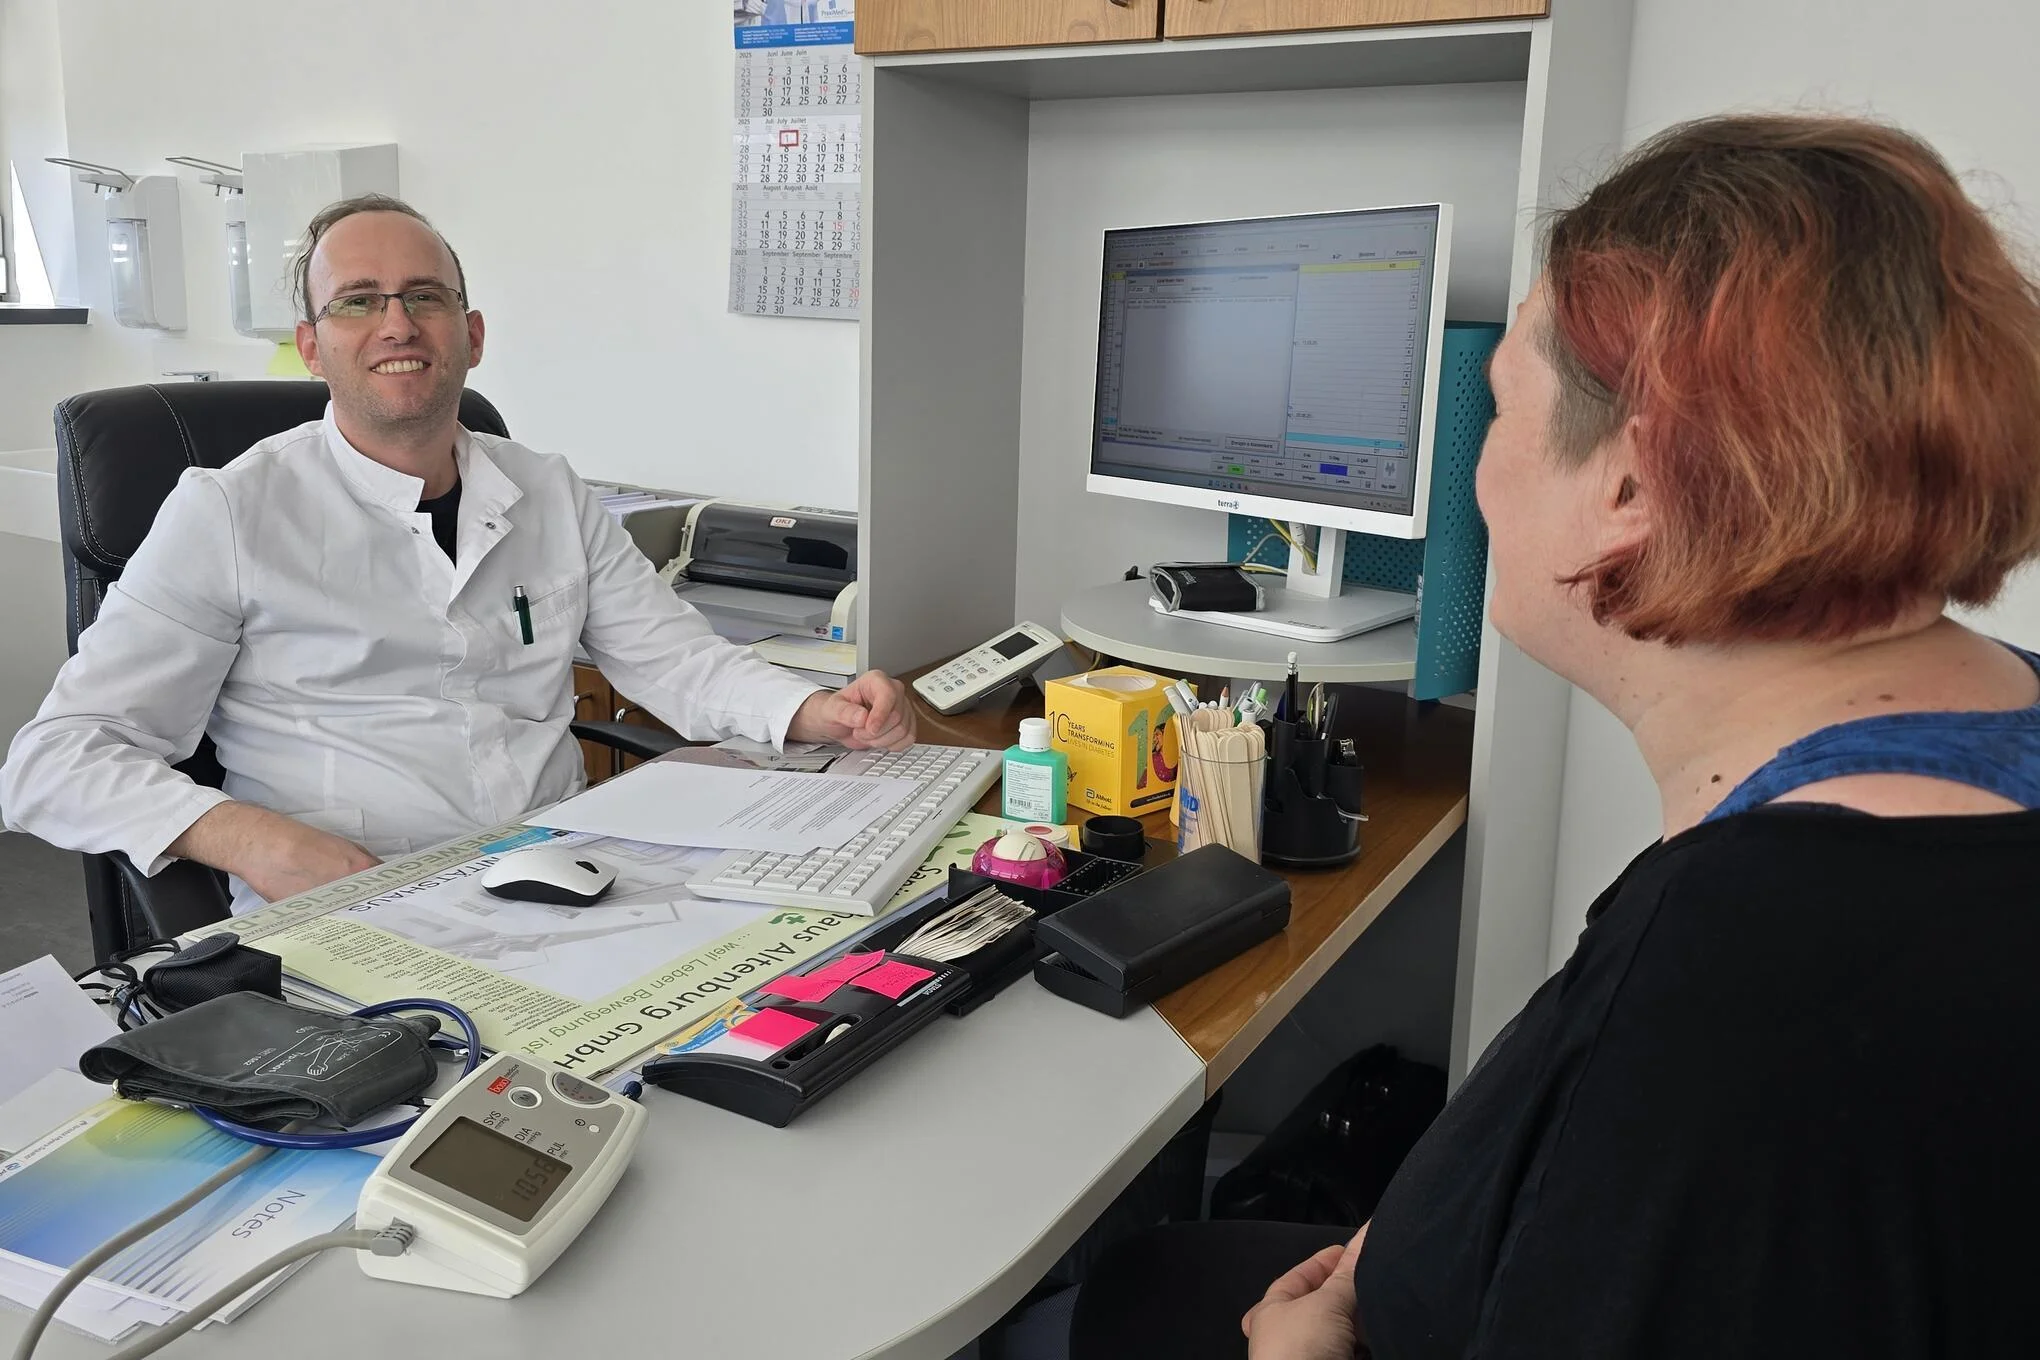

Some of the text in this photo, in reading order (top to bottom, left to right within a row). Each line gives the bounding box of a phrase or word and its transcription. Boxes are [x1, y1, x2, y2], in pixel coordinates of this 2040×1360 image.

[782, 77, 792, 86] 10
[800, 75, 809, 85] 11
[819, 75, 829, 85] 12
[838, 74, 848, 84] 13
[764, 87, 773, 97] 16
[782, 86, 791, 96] 17
[800, 86, 810, 95] 18
[836, 84, 847, 94] 20
[762, 97, 773, 107] 23
[781, 97, 791, 106] 24
[799, 96, 810, 106] 25
[817, 95, 828, 105] 26
[836, 95, 847, 104] 27
[762, 107, 773, 117] 30
[817, 143, 827, 153] 10
[836, 143, 845, 152] 11
[762, 153, 845, 163] 14 15 16 17 18
[760, 163, 844, 173] 21 22 23 24 25
[760, 173, 824, 183] 28 29 30 31
[761, 220, 769, 229] 11
[778, 220, 788, 229] 12
[796, 220, 806, 230] 13
[814, 221, 824, 230] 14
[760, 230, 770, 239] 18
[778, 230, 788, 240] 19
[795, 230, 806, 240] 20
[813, 231, 823, 240] 21
[832, 231, 843, 241] 22
[760, 240, 770, 249] 25
[777, 240, 788, 250] 26
[795, 240, 806, 250] 27
[813, 241, 824, 250] 28
[832, 241, 843, 251] 29
[795, 277, 804, 286] 10
[814, 278, 822, 287] 11
[832, 278, 841, 287] 12
[759, 285, 768, 294] 15
[776, 286, 786, 295] 16
[794, 287, 804, 296] 17
[813, 287, 822, 297] 18
[831, 288, 841, 298] 19
[757, 295, 767, 304] 22
[774, 295, 785, 305] 23
[792, 297, 803, 305] 24
[811, 297, 821, 307] 25
[829, 298, 840, 307] 26
[756, 304, 785, 314] 29 30
[1217, 499, 1233, 508] terra
[775, 517, 792, 525] OKI
[1068, 721, 1086, 733] YEARS
[1067, 729, 1115, 750] TRANSFORMING
[348, 856, 500, 912] NITÄTSHAUS
[650, 958, 708, 989] Leben
[639, 941, 796, 1020] Altenburg
[549, 988, 653, 1039] Bewegung
[521, 1036, 553, 1055] ist
[552, 1021, 643, 1070] GmbH
[483, 1110, 502, 1126] SYS
[514, 1126, 533, 1142] DIA
[546, 1141, 566, 1156] PUL
[231, 1189, 307, 1239] Notes
